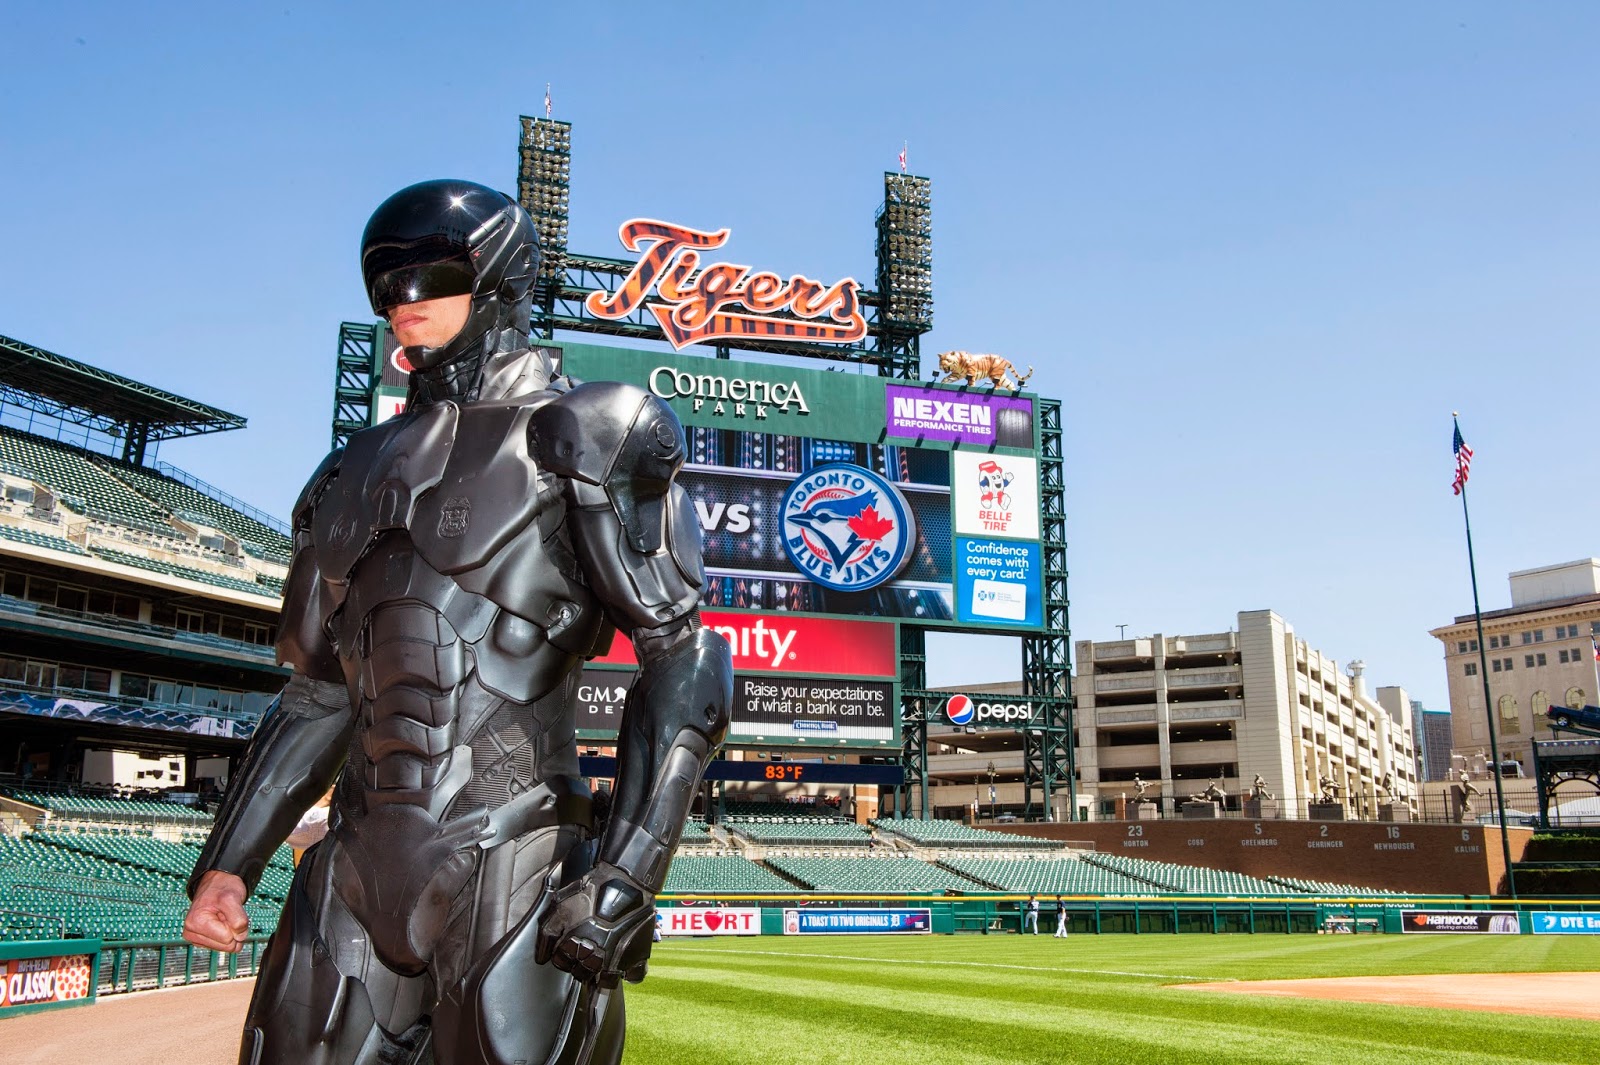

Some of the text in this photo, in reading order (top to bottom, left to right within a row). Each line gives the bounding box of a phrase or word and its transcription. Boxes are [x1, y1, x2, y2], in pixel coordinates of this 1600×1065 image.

[585, 218, 867, 350] Tigers
[693, 398, 767, 418] PARK
[893, 396, 991, 426] NEXEN
[893, 418, 991, 435] PERFORMANCE TIRES
[790, 473, 865, 510] TORONTO
[979, 510, 1012, 521] BELLE
[983, 521, 1007, 531] TIRE
[966, 541, 1029, 557] Confidence
[789, 534, 891, 583] BLUE JAYS
[966, 555, 1029, 568] comes with
[967, 567, 997, 580] every
[744, 681, 884, 702] Raise your expectations
[747, 698, 885, 717] of what a bank can be.
[977, 702, 1032, 722] pepsi
[1127, 826, 1143, 837] 23
[1254, 824, 1262, 835] 5
[1320, 825, 1328, 837] 2
[1387, 827, 1400, 839] 16
[1461, 830, 1470, 841] 6
[1241, 839, 1278, 847] GREENBERG
[802, 916, 807, 927] A
[808, 916, 829, 927] TOAST
[830, 916, 839, 927] TO
[840, 916, 853, 927] TWO
[854, 916, 889, 927] ORIGINALS
[1561, 917, 1584, 928] DTE
[9, 970, 55, 1003] CLASSIC
